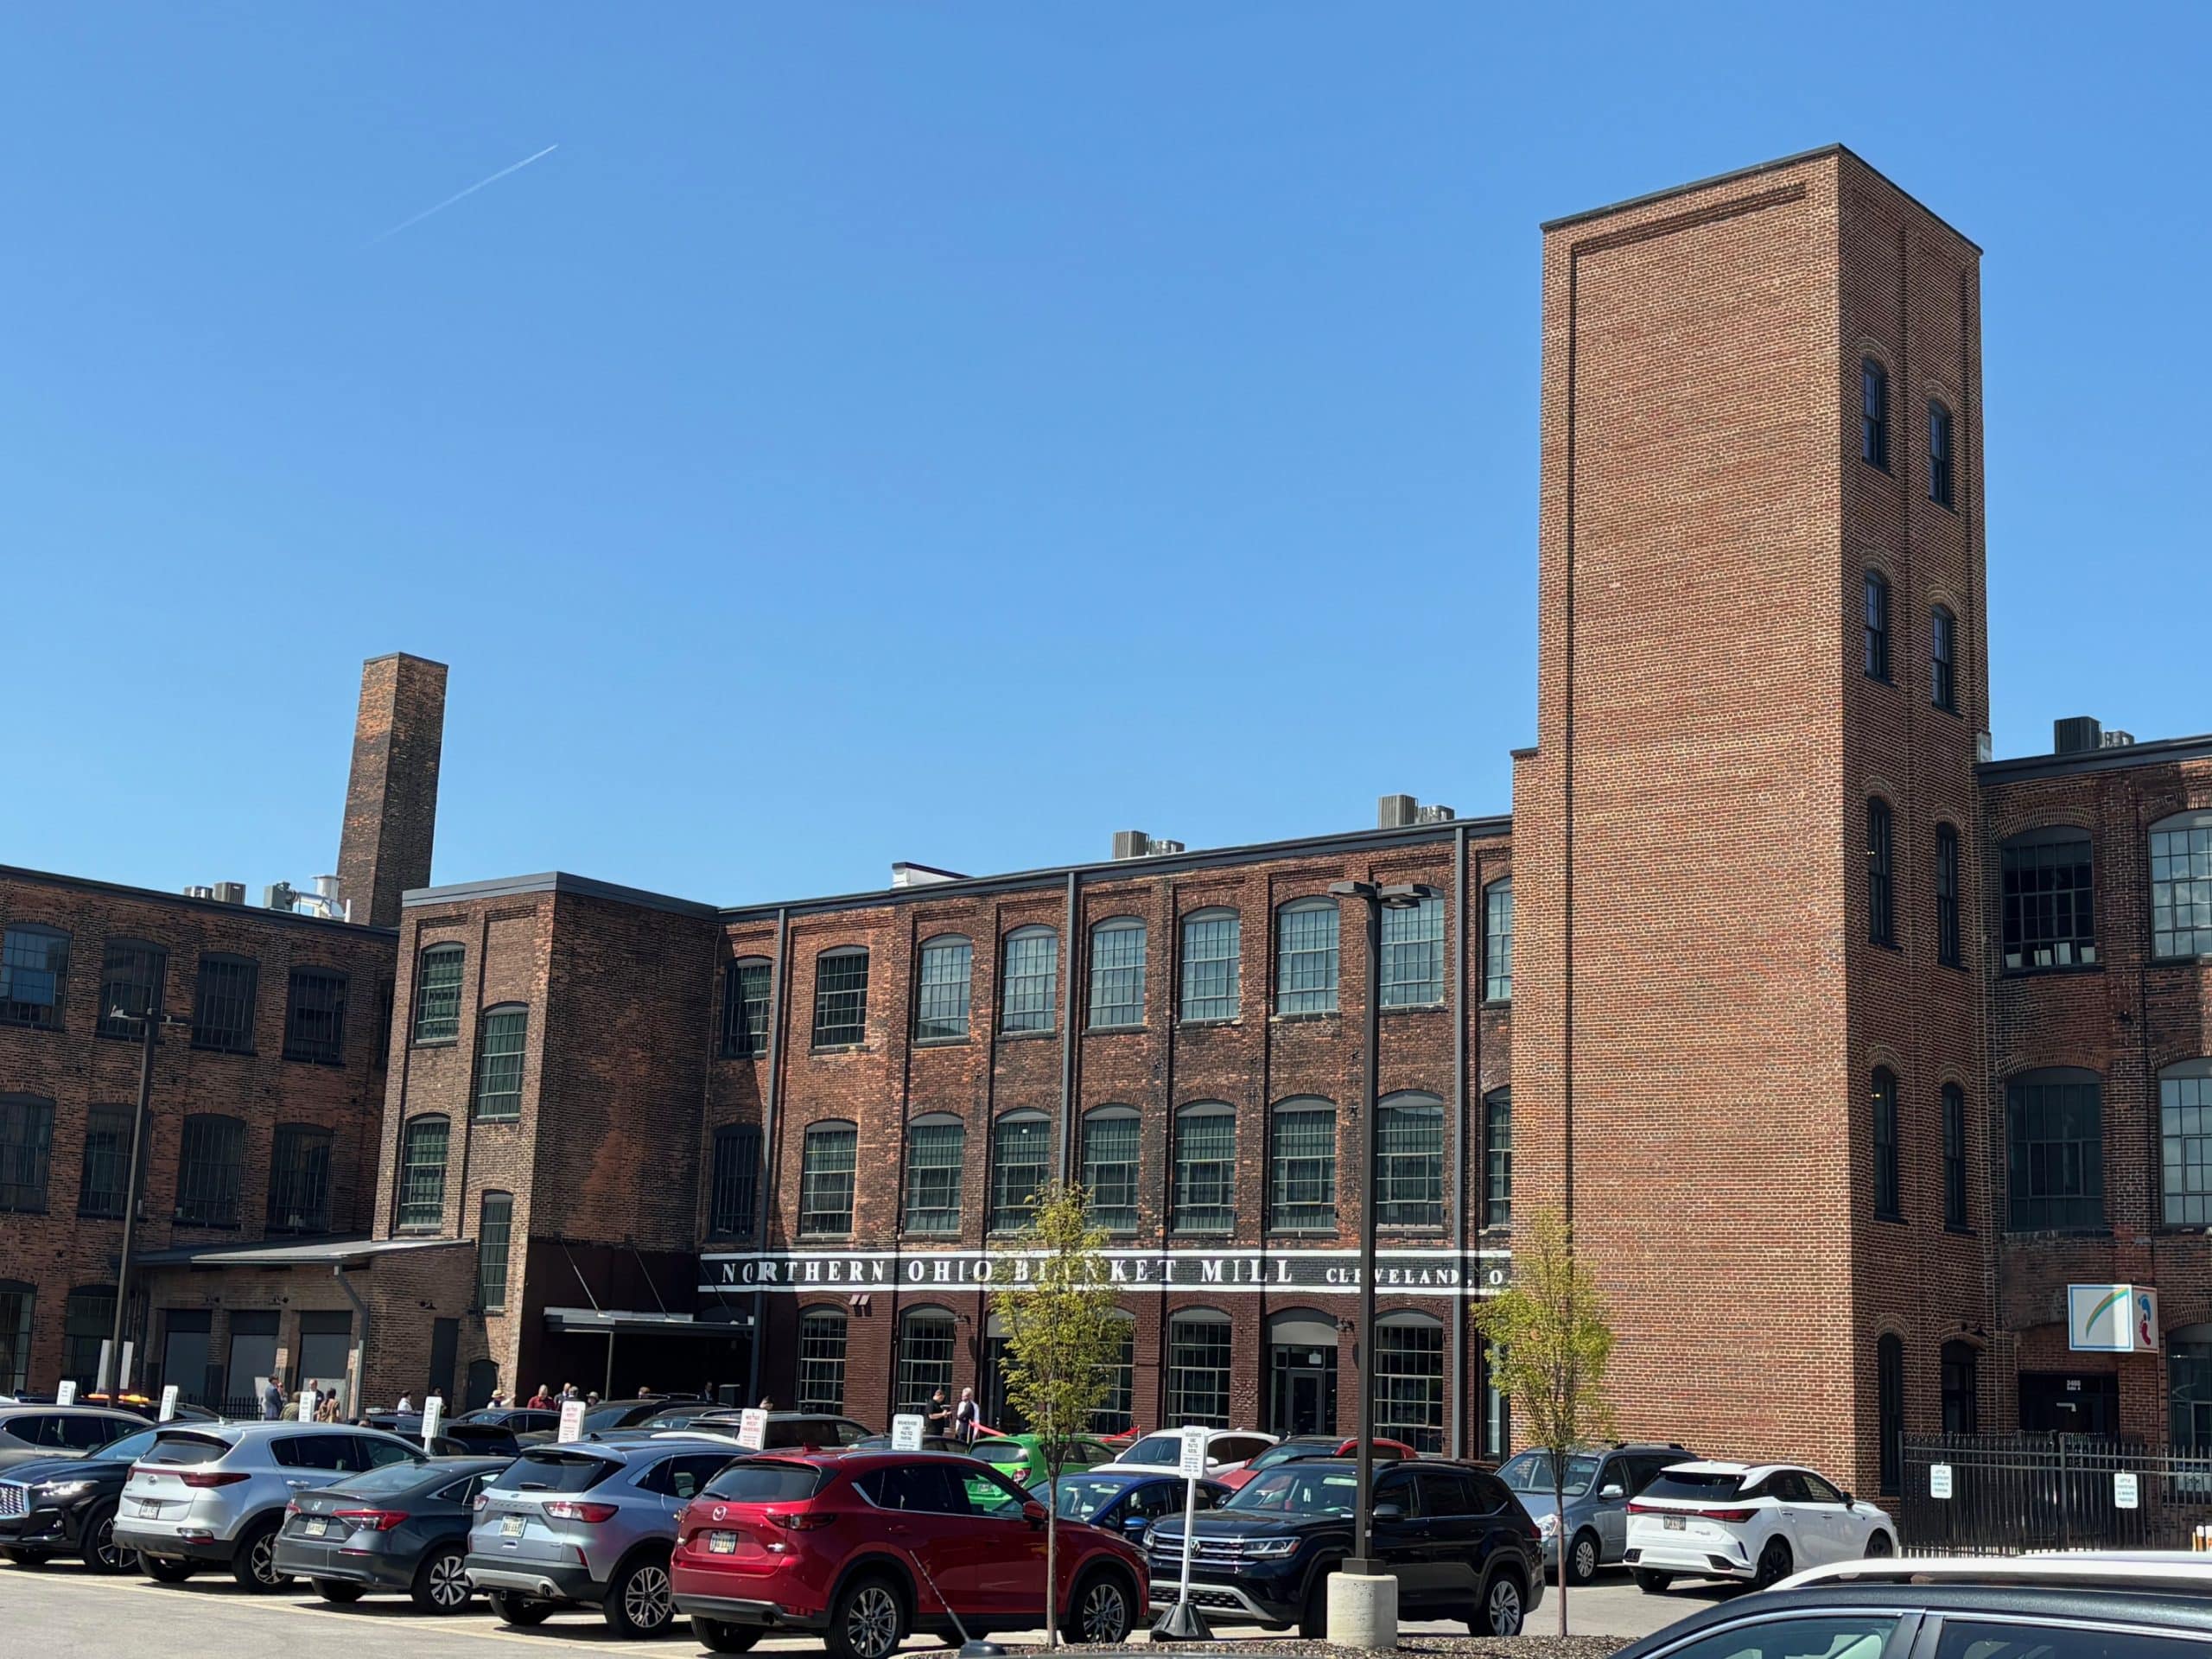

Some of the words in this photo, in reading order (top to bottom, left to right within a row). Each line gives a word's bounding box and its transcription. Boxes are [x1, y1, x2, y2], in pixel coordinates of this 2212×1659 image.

[721, 1261, 885, 1283] NORTHERN
[908, 1260, 993, 1282] OHIO
[1200, 1259, 1293, 1283] MILL
